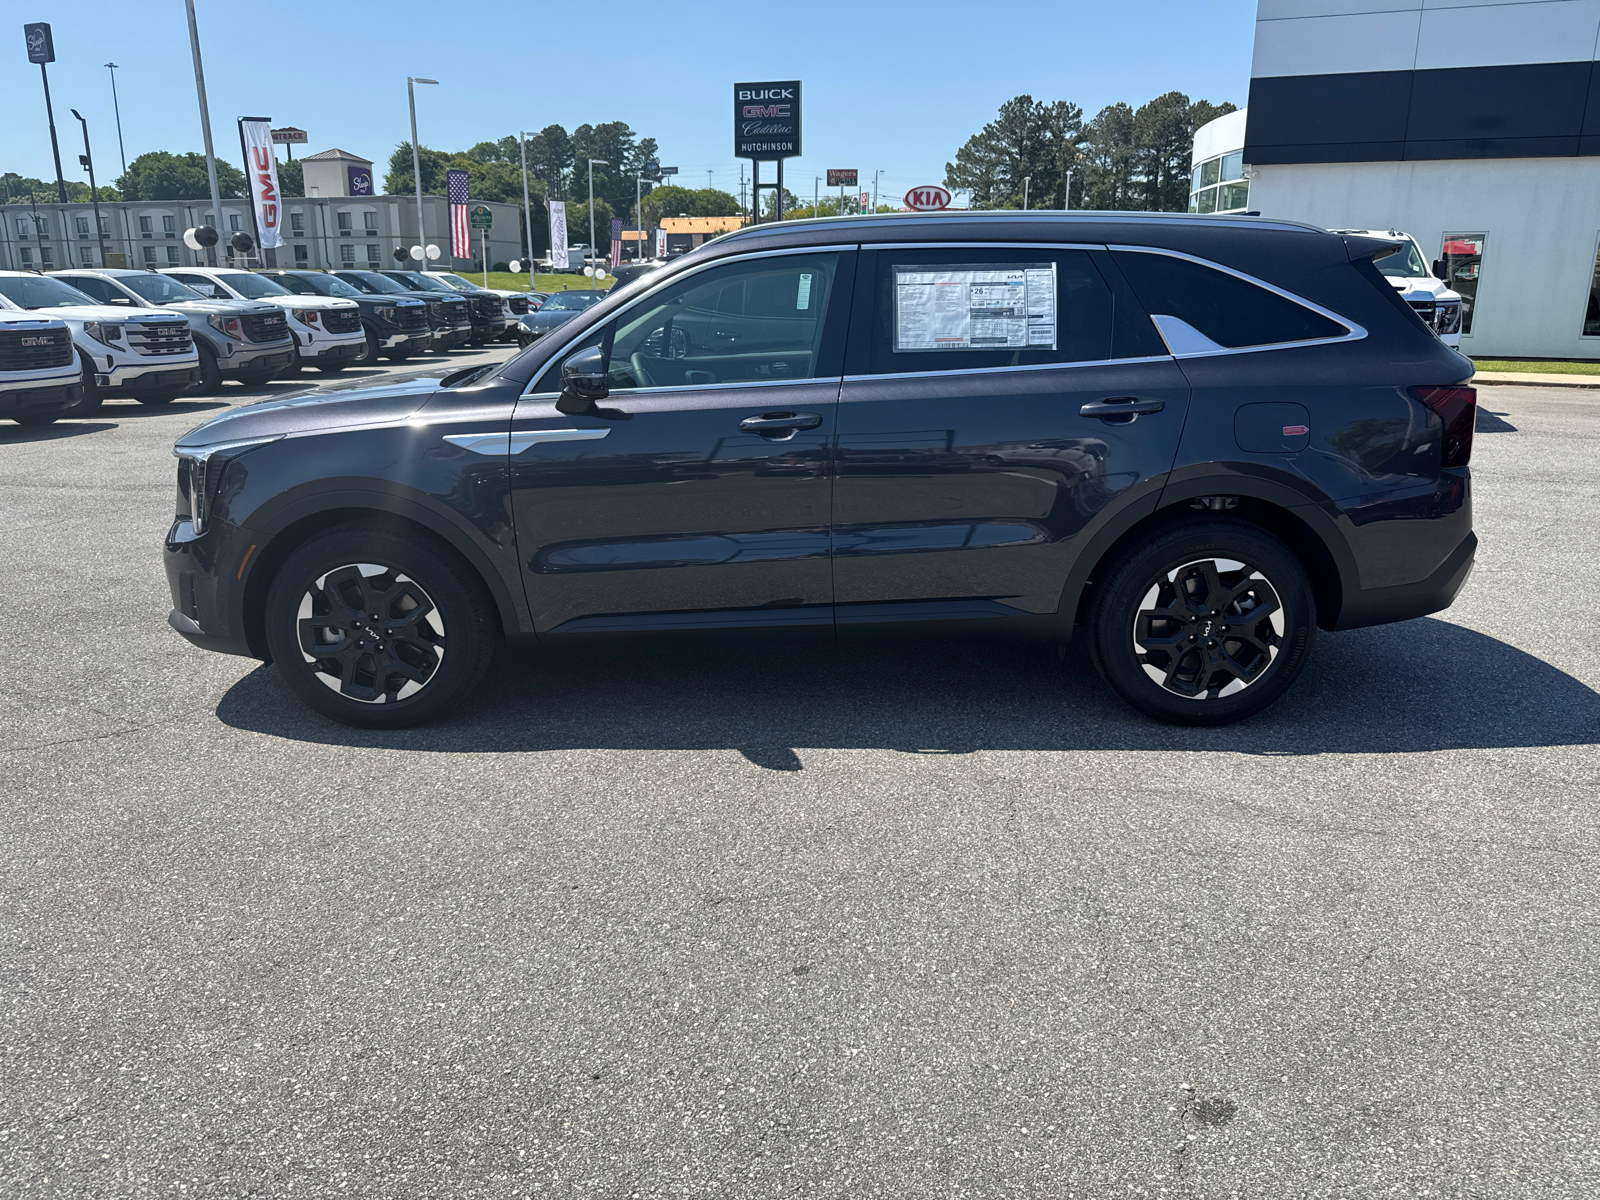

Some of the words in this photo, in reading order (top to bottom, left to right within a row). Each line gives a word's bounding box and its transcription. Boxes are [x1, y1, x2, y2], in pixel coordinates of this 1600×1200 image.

[739, 89, 793, 100] BUICK
[743, 104, 791, 117] GMC
[742, 120, 792, 136] Cadillac
[272, 132, 304, 140] UTBACK
[741, 142, 793, 151] HUTCHINSON
[829, 170, 856, 178] Wagers
[253, 147, 277, 228] GMC
[913, 191, 944, 206] KIA
[554, 217, 566, 260] Cadillac
[158, 328, 181, 336] GMC
[22, 336, 54, 346] GMC
